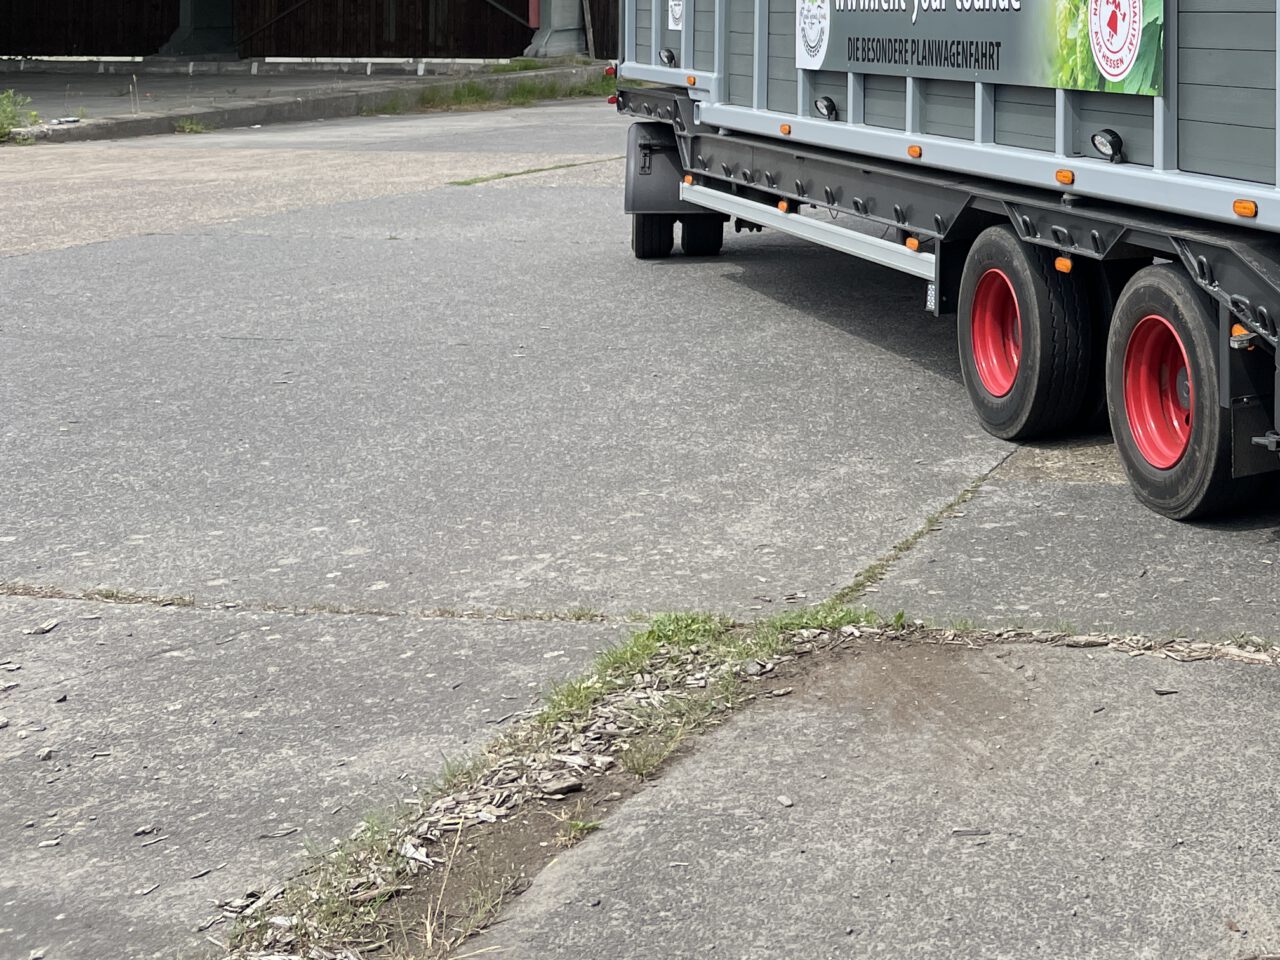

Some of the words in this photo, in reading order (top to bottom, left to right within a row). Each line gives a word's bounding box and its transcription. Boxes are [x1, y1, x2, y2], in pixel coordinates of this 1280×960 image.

[848, 36, 860, 62] DIE
[861, 37, 909, 65] BESONDERE
[911, 38, 1002, 71] PLANWAGENFAHRT
[1101, 51, 1125, 69] HESSEN
